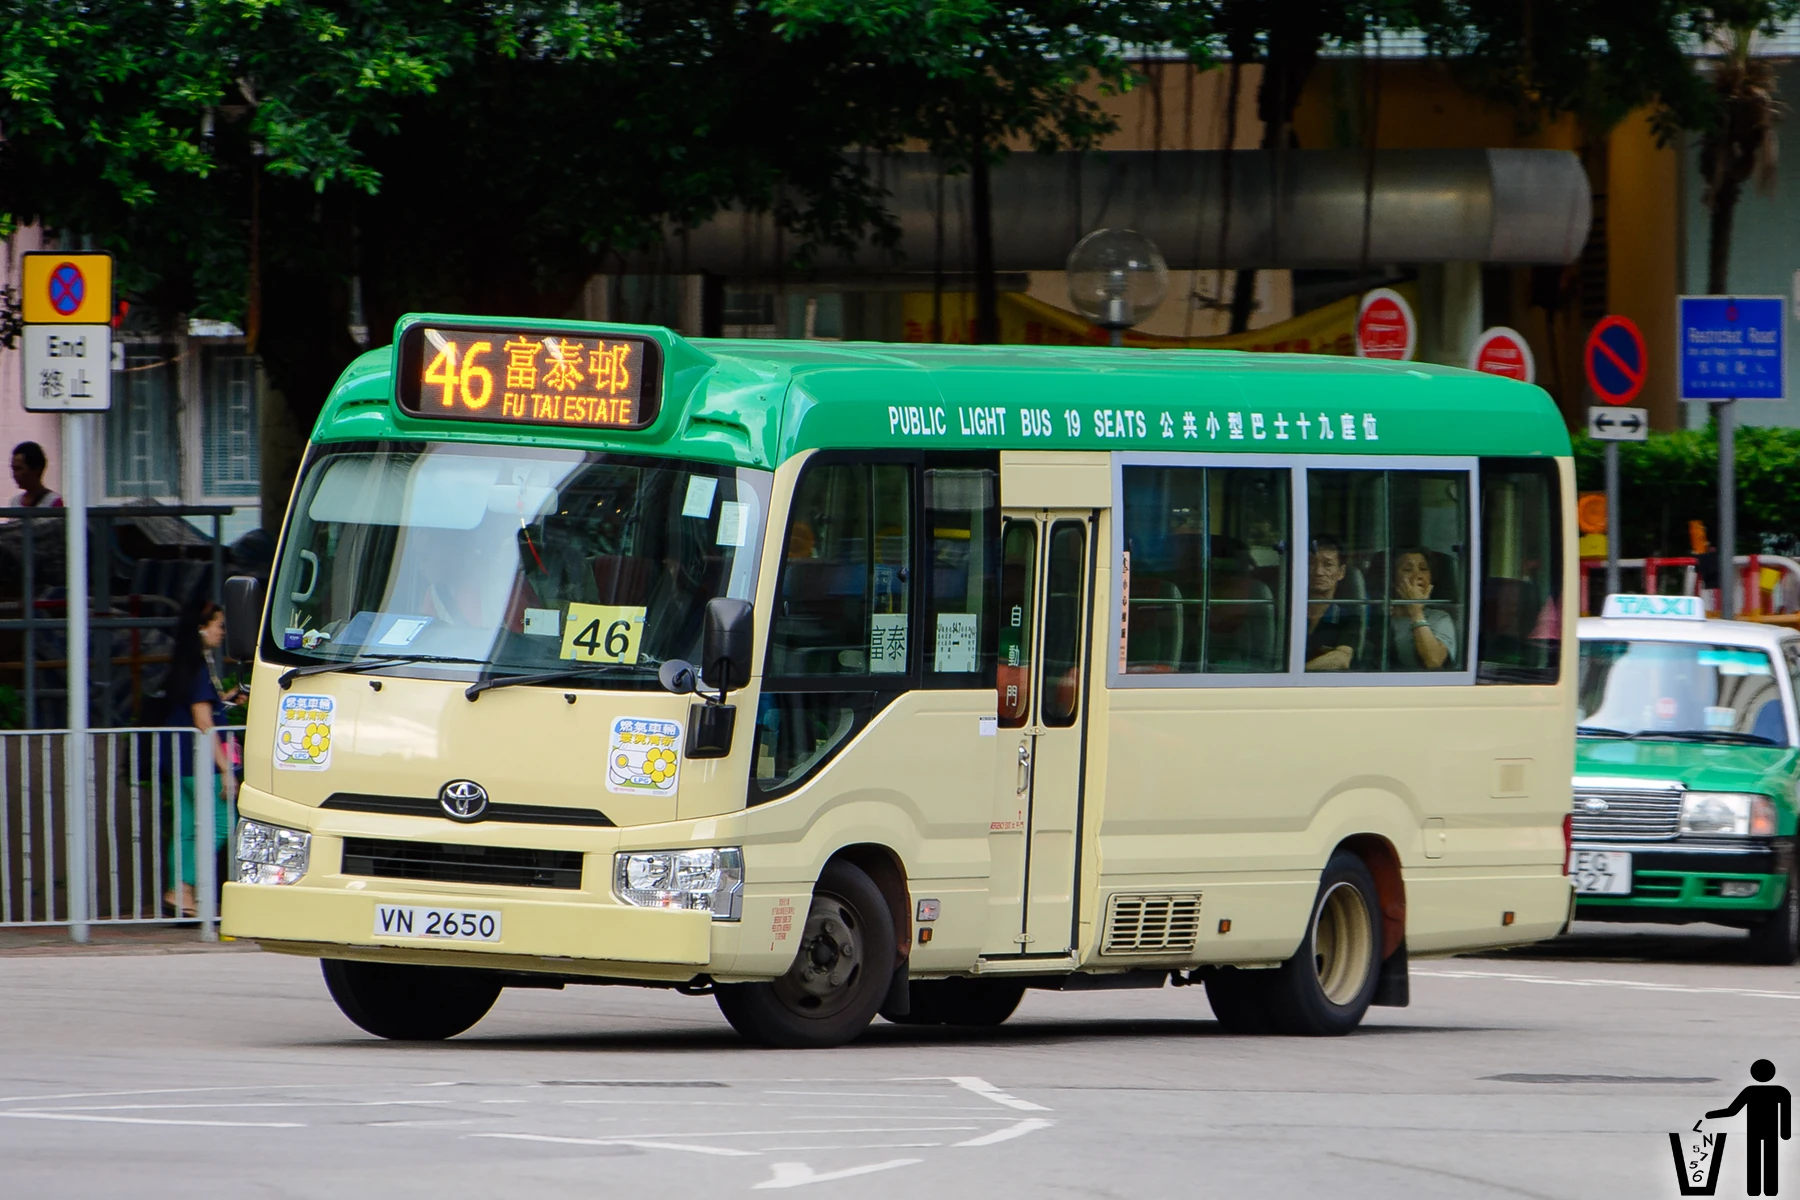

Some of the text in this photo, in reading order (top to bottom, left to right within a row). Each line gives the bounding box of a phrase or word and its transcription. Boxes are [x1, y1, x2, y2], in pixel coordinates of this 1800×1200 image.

[47, 335, 86, 357] End
[424, 341, 493, 410] 46
[502, 335, 632, 395] 富泰邨
[40, 368, 93, 399] 終止
[502, 392, 632, 425] FU TAI ESTATE
[888, 406, 1147, 438] PUBLIC LIGHT BUS 19 SEATS
[1159, 412, 1379, 441] 公共小型巴士十九座位
[1616, 596, 1695, 616] TAXI
[572, 618, 631, 658] 46
[871, 624, 906, 661] 富泰
[1005, 604, 1022, 706] 自動門
[633, 776, 650, 784] LPG
[1575, 852, 1607, 872] EG
[380, 908, 495, 938] VN 2650
